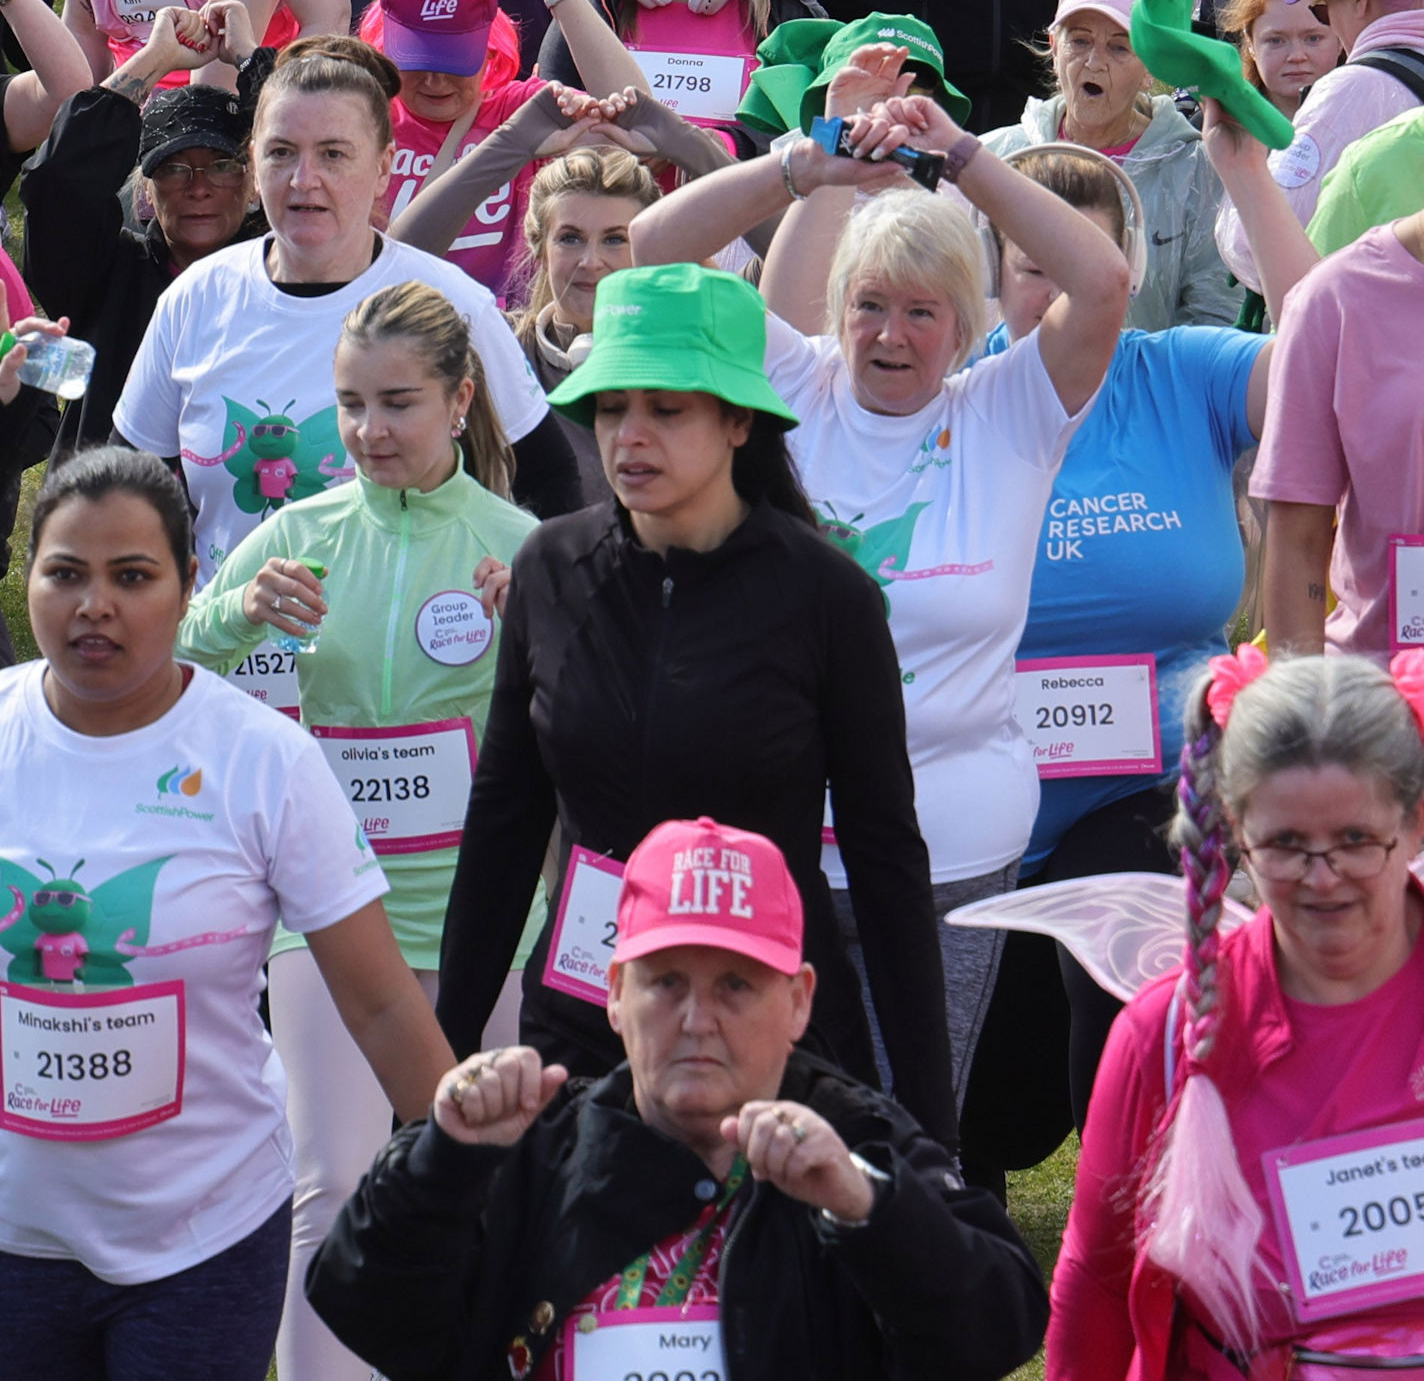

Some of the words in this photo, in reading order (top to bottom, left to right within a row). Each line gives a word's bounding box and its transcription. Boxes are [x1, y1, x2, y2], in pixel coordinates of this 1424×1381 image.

[667, 57, 703, 67] Donna
[653, 73, 711, 92] 21798
[1049, 493, 1148, 517] CANCER
[1048, 511, 1182, 539] RESEARCH
[1046, 540, 1084, 561] UK
[431, 601, 468, 616] Group
[432, 612, 474, 626] leader
[235, 651, 296, 676] 21527
[1040, 675, 1105, 690] Rebecca
[1035, 703, 1114, 729] 20912
[341, 746, 389, 761] olivia's
[394, 744, 435, 758] team
[1033, 746, 1047, 758] for
[1048, 741, 1074, 759] Life
[351, 774, 430, 802] 22138
[135, 802, 215, 822] ScottishPower
[674, 847, 715, 871] RACE
[719, 847, 751, 870] FOR
[668, 870, 753, 918] LIFE
[559, 951, 586, 971] Race
[17, 1008, 102, 1033] Minakshi's
[109, 1009, 156, 1028] team
[37, 1049, 133, 1080] 21388
[7, 1091, 33, 1111] Race
[34, 1096, 49, 1111] for
[50, 1097, 81, 1112] Life
[1326, 1154, 1398, 1187] Janet's
[1308, 1262, 1349, 1291] Race
[1351, 1260, 1371, 1277] for
[1371, 1247, 1408, 1273] Life
[658, 1333, 712, 1352] Mary
